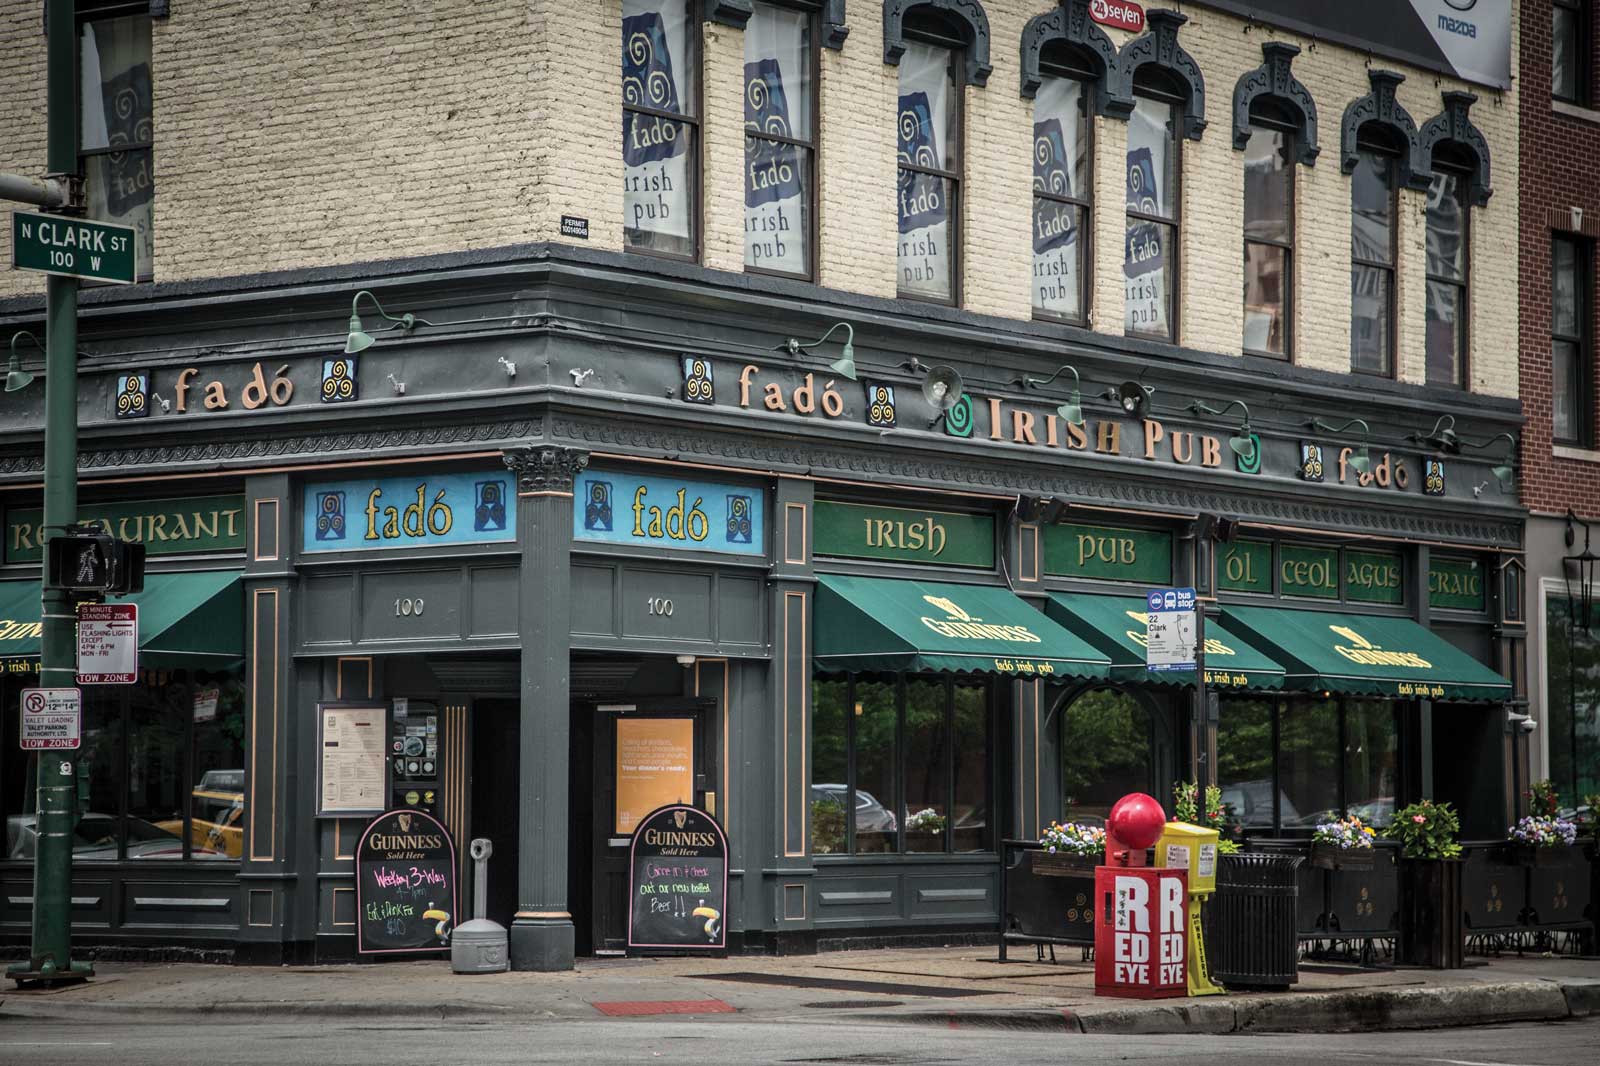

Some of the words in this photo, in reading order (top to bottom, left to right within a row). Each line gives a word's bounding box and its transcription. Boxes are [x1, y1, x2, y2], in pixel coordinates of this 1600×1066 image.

[624, 165, 673, 192] irish
[750, 156, 792, 191] fadó
[633, 193, 669, 229] pub
[901, 184, 939, 217] fadó
[22, 223, 31, 239] N
[38, 222, 106, 252] CLARK
[111, 236, 127, 252] ST
[752, 233, 786, 265] pub
[50, 250, 74, 267] 100
[90, 255, 101, 272] W
[903, 257, 934, 287] pub
[1033, 252, 1069, 277] irish
[1040, 277, 1066, 309] pub
[1132, 301, 1158, 329] pub
[175, 361, 294, 412] fadó
[738, 364, 843, 417] fadó
[988, 398, 1122, 454] IRISH
[1143, 419, 1222, 467] PUB
[364, 482, 453, 540] fadó
[632, 485, 709, 541] fadó
[1282, 558, 1337, 588] CEOL
[1347, 562, 1401, 589] AGUS
[394, 598, 425, 616] 100
[648, 597, 674, 616] 100
[1177, 600, 1194, 608] stop
[1178, 591, 1191, 600] bus
[921, 616, 1042, 643] GUINNESS
[1149, 615, 1158, 623] 22
[1149, 624, 1167, 632] Clark
[80, 674, 99, 682] TOW
[104, 674, 129, 682] ZONE
[369, 833, 442, 850] GUINNESS
[645, 828, 716, 847] GUINNESS
[386, 851, 404, 859] Sold
[660, 847, 678, 855] Sold
[680, 848, 699, 856] Here
[640, 881, 656, 895] out
[1115, 876, 1149, 932] R
[1160, 877, 1184, 932] R
[1115, 932, 1149, 963] ED
[1160, 933, 1184, 964] ED
[1115, 963, 1150, 985] EYE
[1160, 963, 1184, 985] EYE
